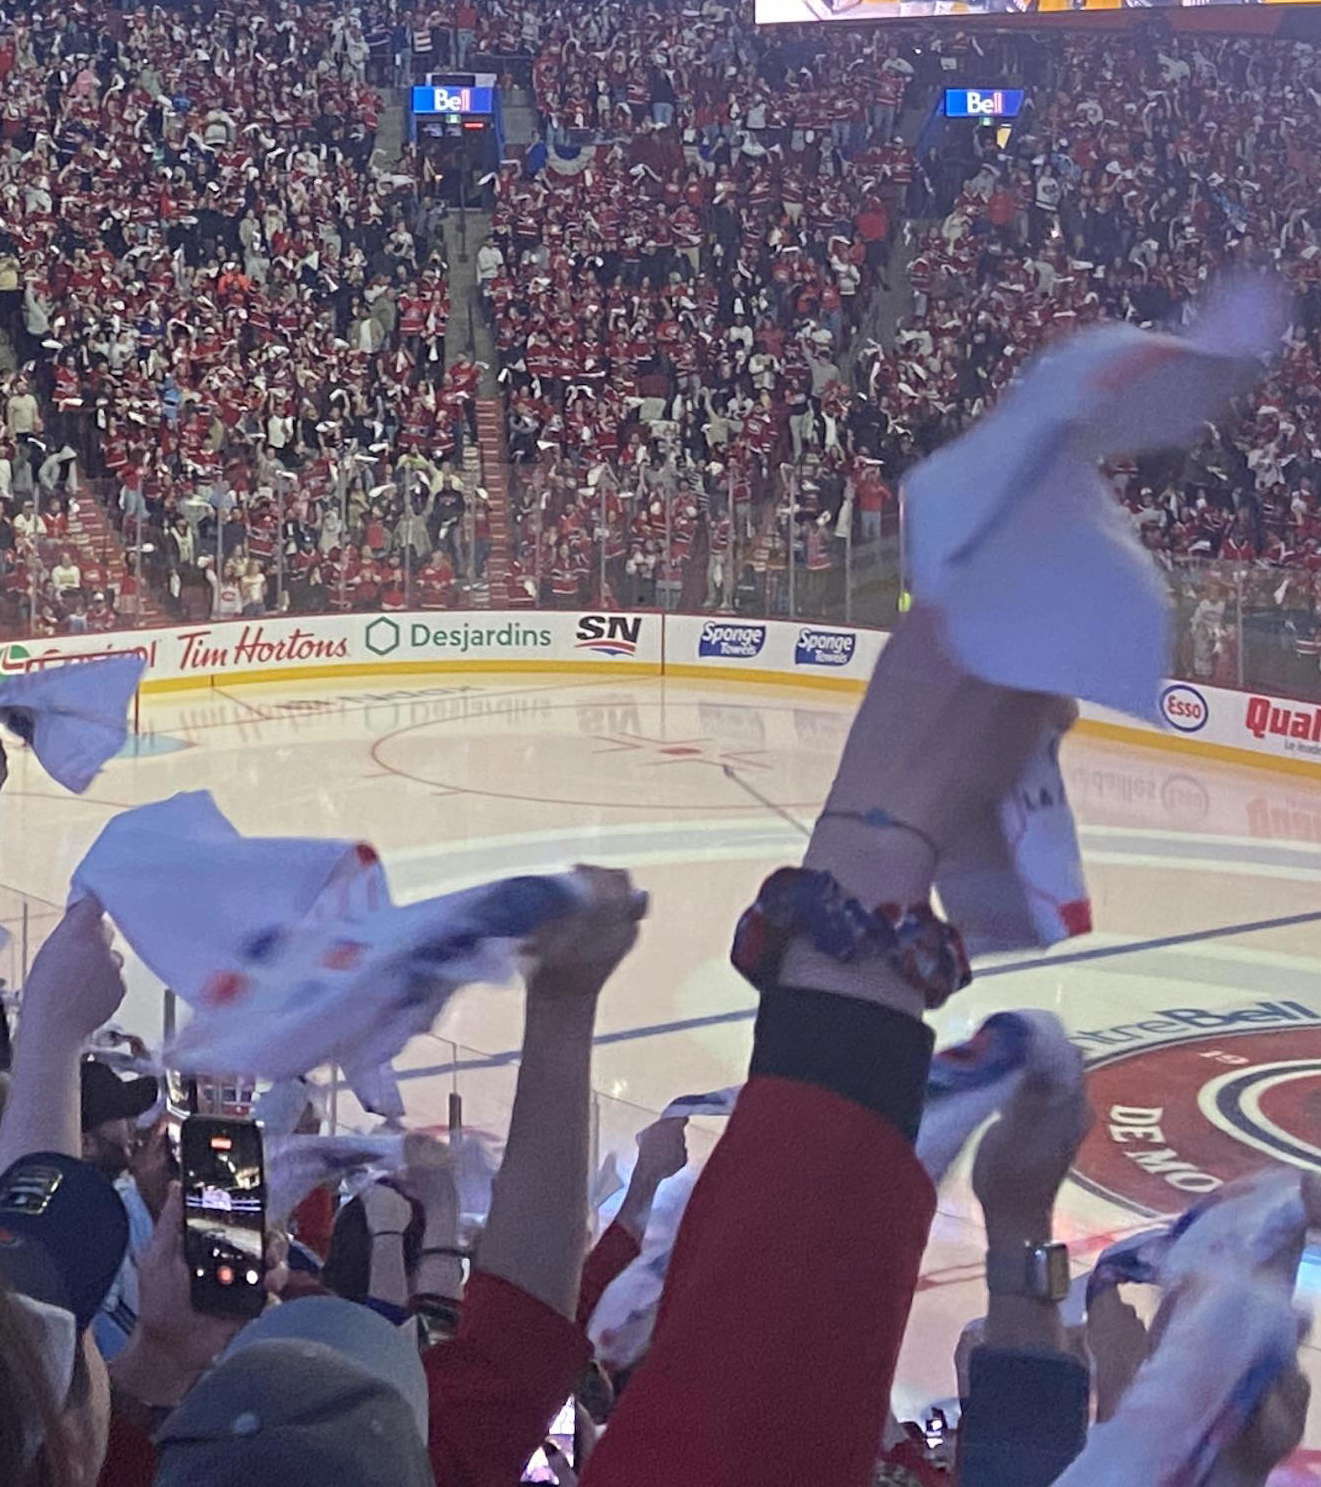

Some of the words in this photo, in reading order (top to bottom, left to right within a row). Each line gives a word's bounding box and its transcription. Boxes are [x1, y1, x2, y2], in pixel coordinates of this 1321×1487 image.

[433, 87, 471, 112] Bell
[966, 91, 1003, 115] Bell
[410, 623, 553, 652] Desjardins
[575, 615, 642, 644] SN
[701, 620, 764, 649] Sponge
[797, 628, 854, 654] Sponge
[177, 631, 228, 670] Tim
[233, 625, 350, 665] Hortons
[719, 641, 757, 656] Towels
[814, 649, 850, 665] Towels
[1166, 694, 1202, 720] Esso
[1196, 1050, 1250, 1066] 19
[1108, 1103, 1166, 1145] DE
